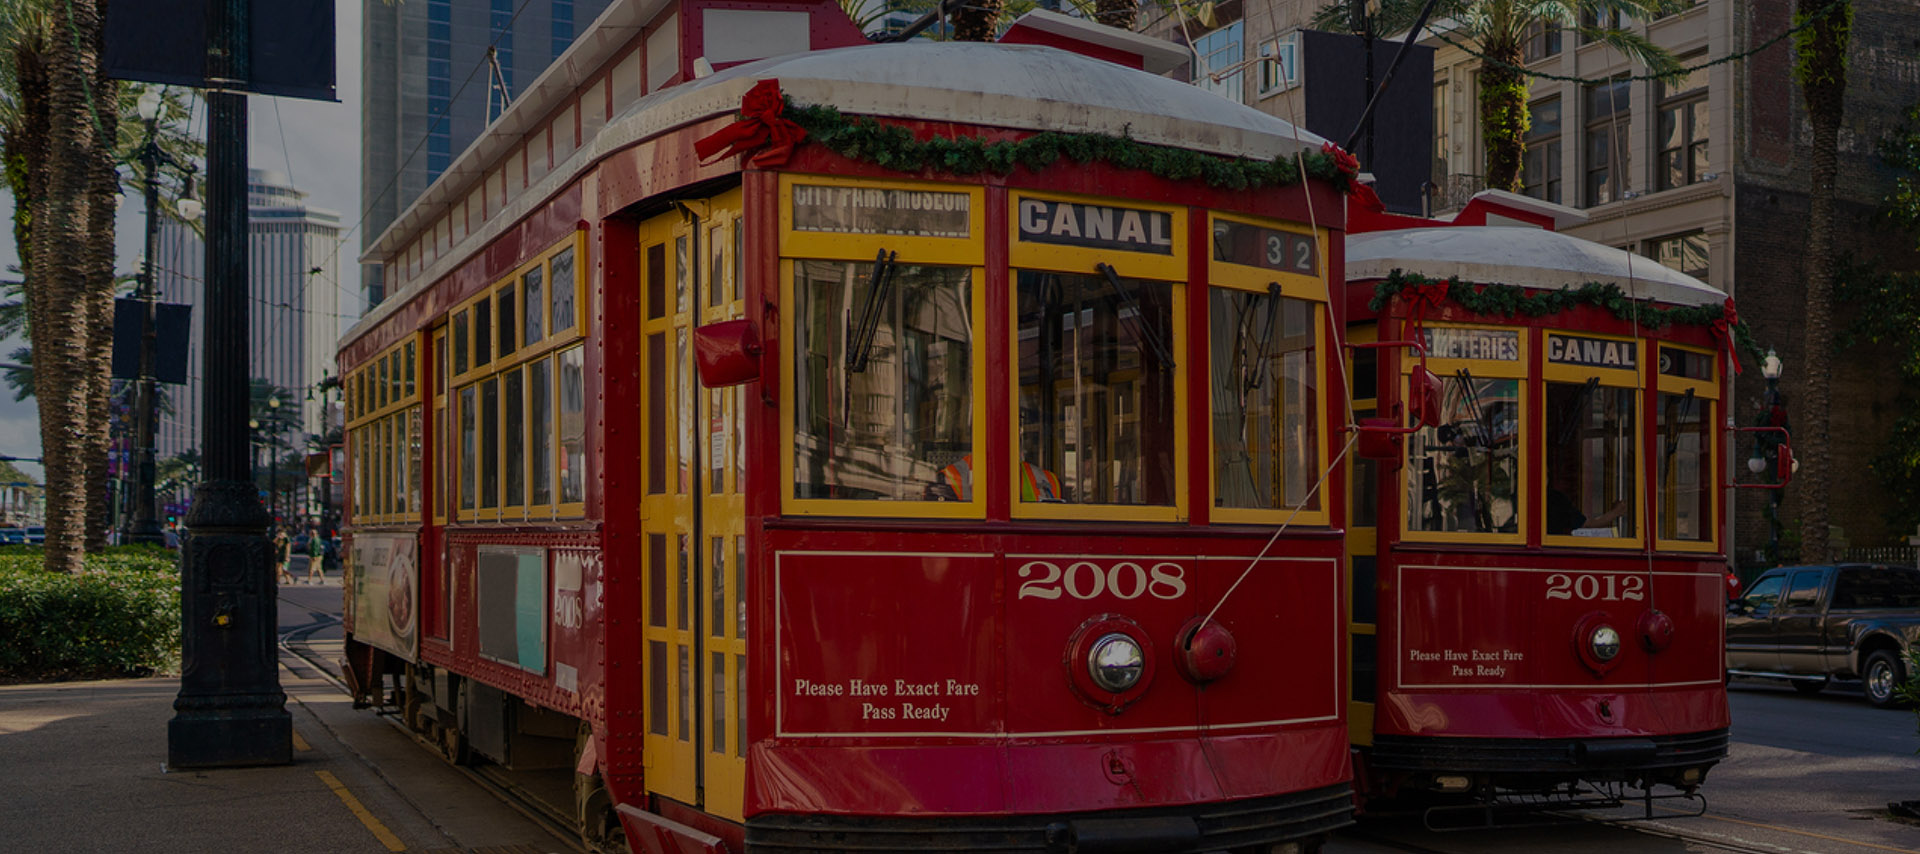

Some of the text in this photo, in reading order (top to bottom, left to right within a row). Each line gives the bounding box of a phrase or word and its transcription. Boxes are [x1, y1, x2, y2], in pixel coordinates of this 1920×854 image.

[1020, 200, 1171, 245] CANAL
[1411, 333, 1518, 361] EMETERIES
[1549, 336, 1636, 367] CANAL
[1017, 560, 1187, 600] 2008
[1545, 573, 1644, 601] 2012
[1410, 649, 1524, 661] Please Have Exact Fare
[1452, 664, 1506, 678] Pass Ready
[795, 679, 980, 697] Please Have Exact Fare
[862, 702, 950, 722] Pass Ready
